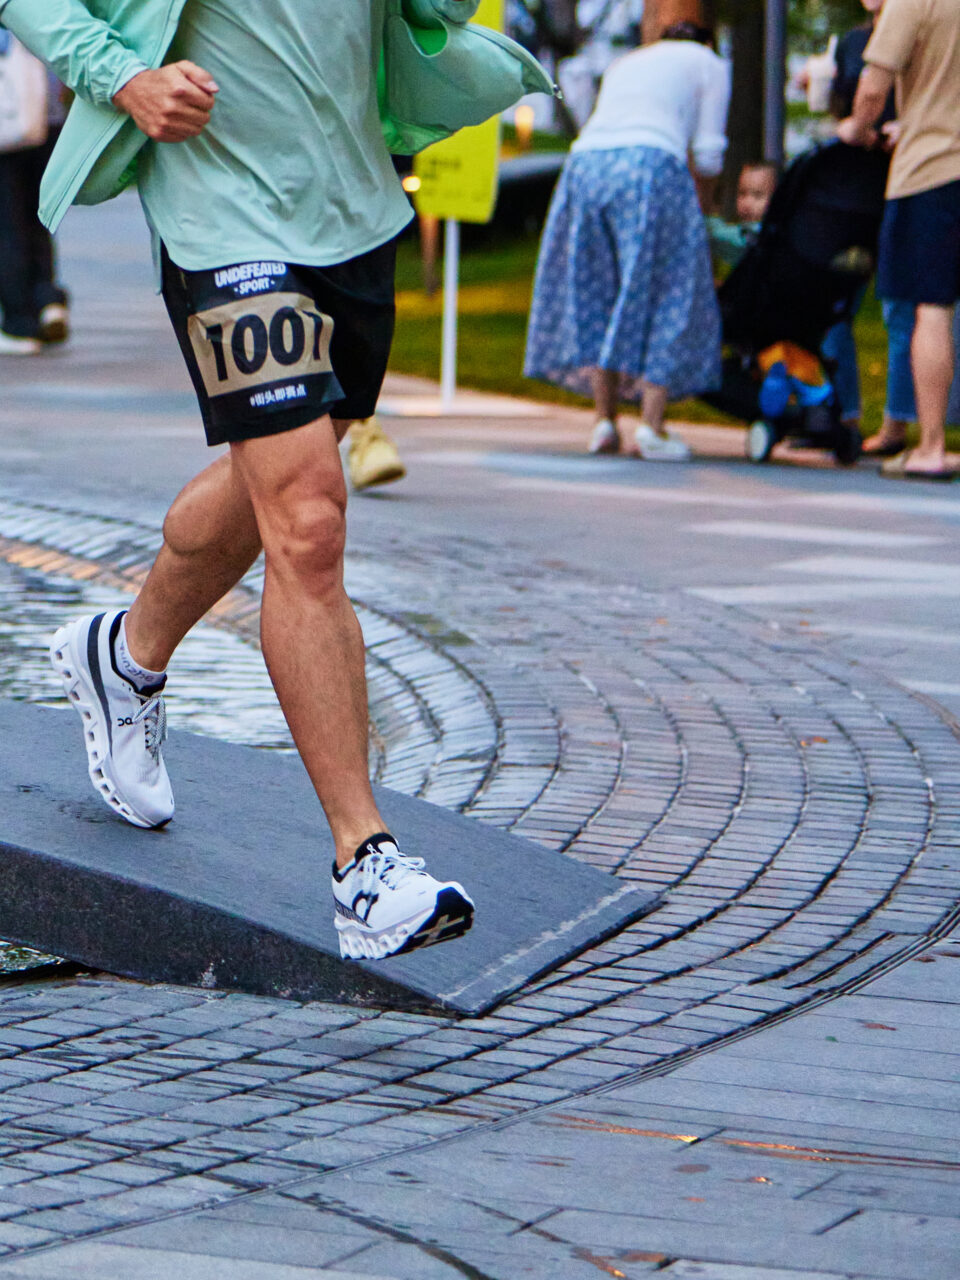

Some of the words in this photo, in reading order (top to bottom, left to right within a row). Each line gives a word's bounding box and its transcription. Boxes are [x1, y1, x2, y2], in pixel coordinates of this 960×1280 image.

[214, 262, 287, 288] UNDEFEATED
[238, 277, 270, 295] SPORT
[206, 306, 323, 382] 1001
